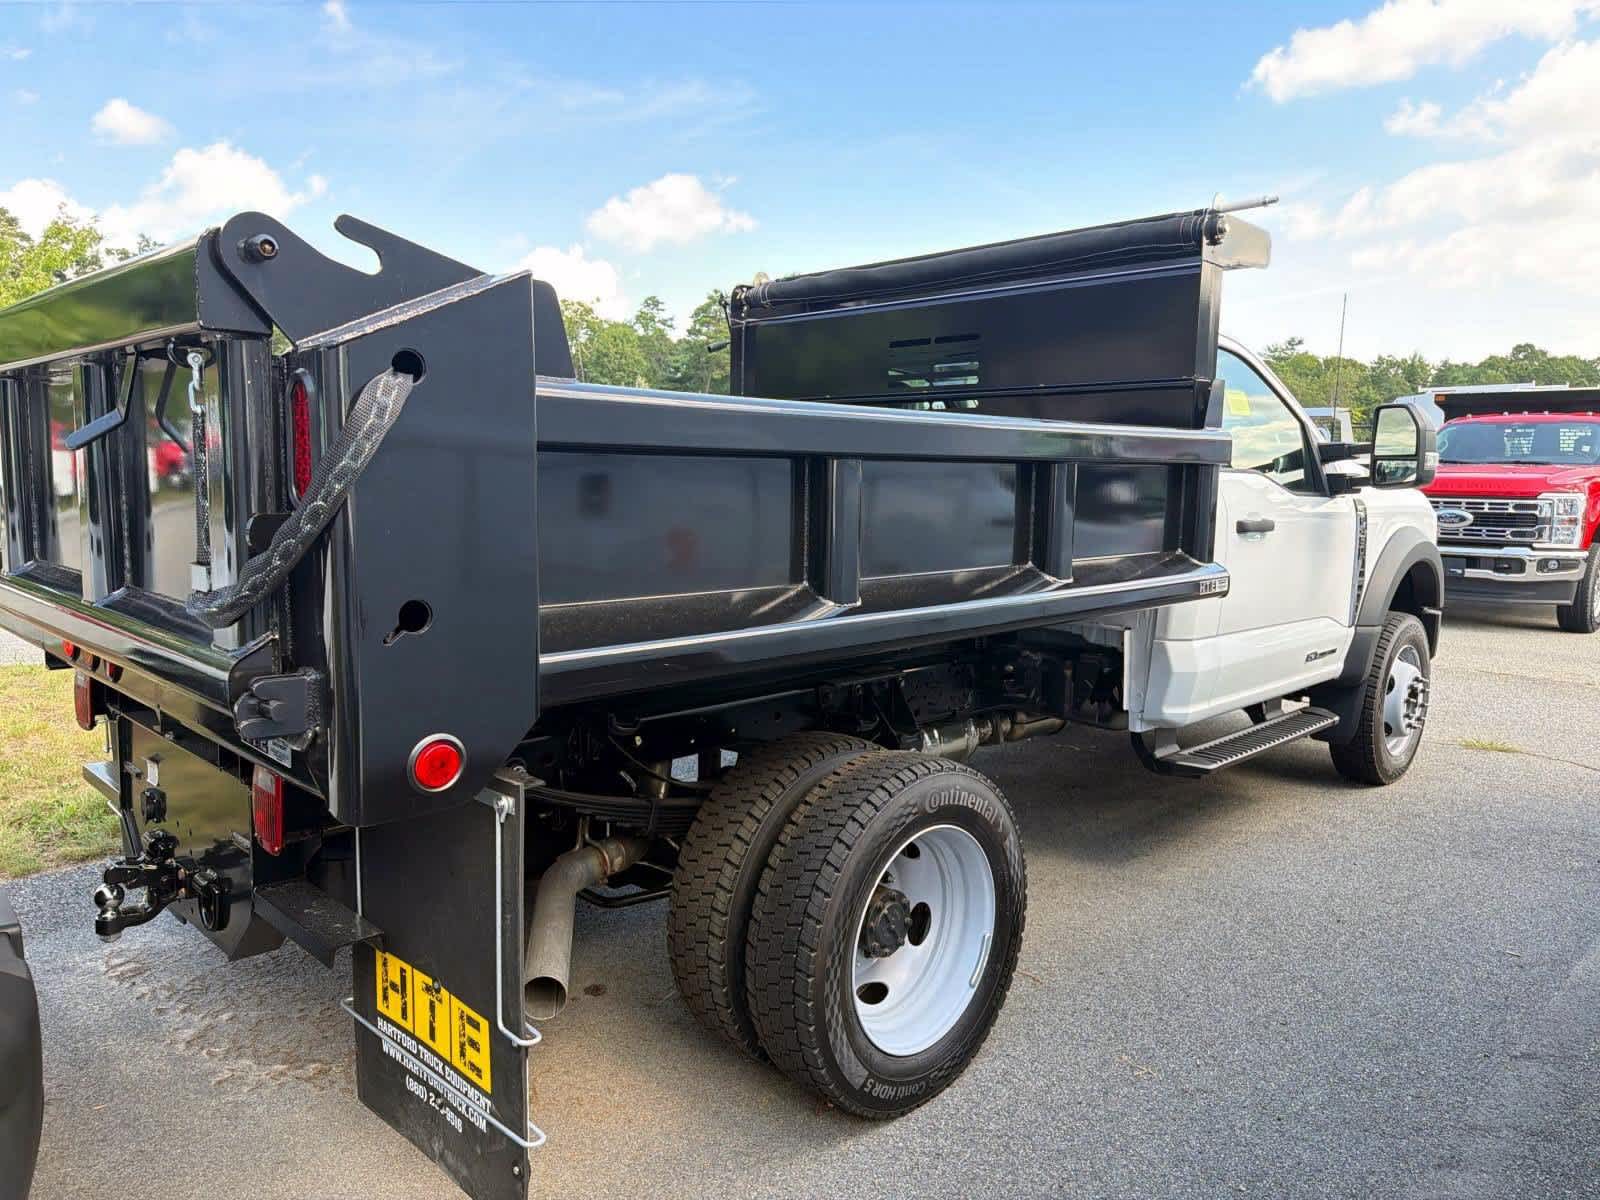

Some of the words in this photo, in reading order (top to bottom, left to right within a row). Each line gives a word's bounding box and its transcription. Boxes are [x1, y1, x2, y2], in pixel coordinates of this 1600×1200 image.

[925, 785, 998, 824] Continental
[377, 1017, 418, 1054] HARTFORD
[418, 1044, 445, 1076] TRUCK
[444, 1065, 492, 1114] EQUIPMENT
